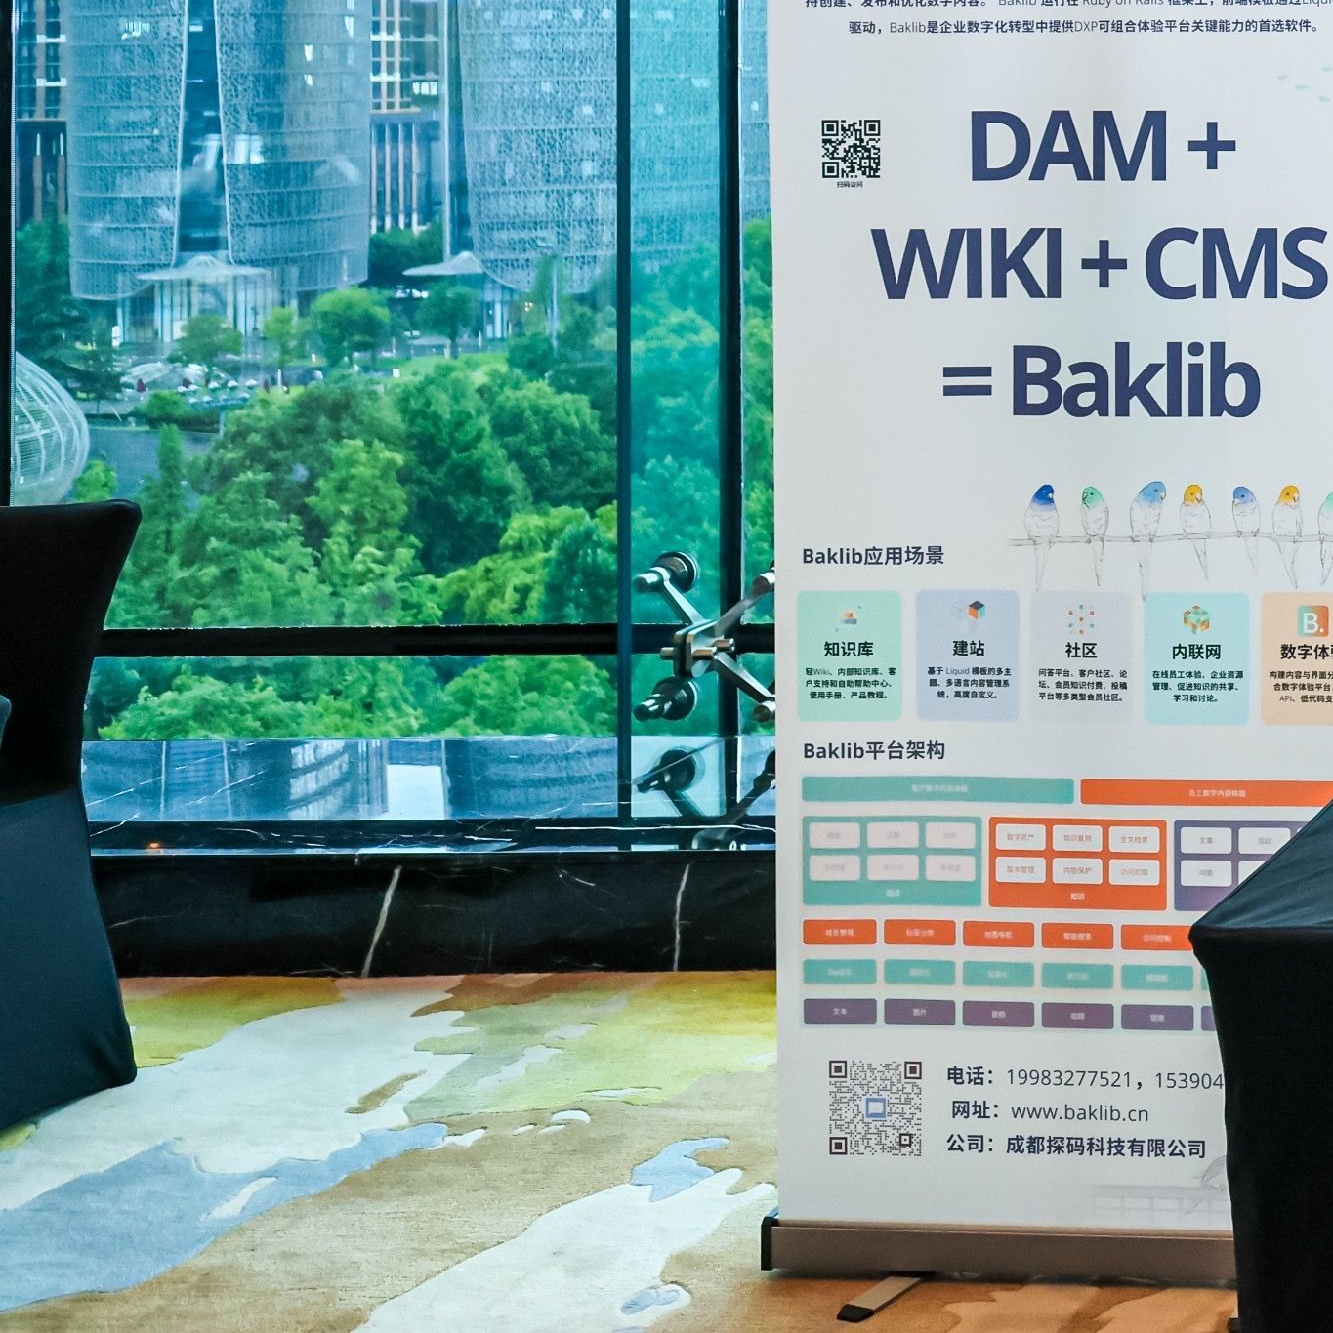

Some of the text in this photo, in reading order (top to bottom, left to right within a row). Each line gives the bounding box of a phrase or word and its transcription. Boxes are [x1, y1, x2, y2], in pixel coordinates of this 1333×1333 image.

[970, 110, 1237, 181] DAM +
[870, 226, 1329, 301] WIKI + CMS
[1011, 340, 1262, 419] Baklib
[801, 544, 945, 567] Baklib应用场景
[823, 641, 874, 657] 知识库
[952, 639, 985, 657] 建站
[1064, 642, 1098, 658] 社区
[1172, 643, 1222, 660] 内联网
[802, 739, 946, 762] Baklib平台架构
